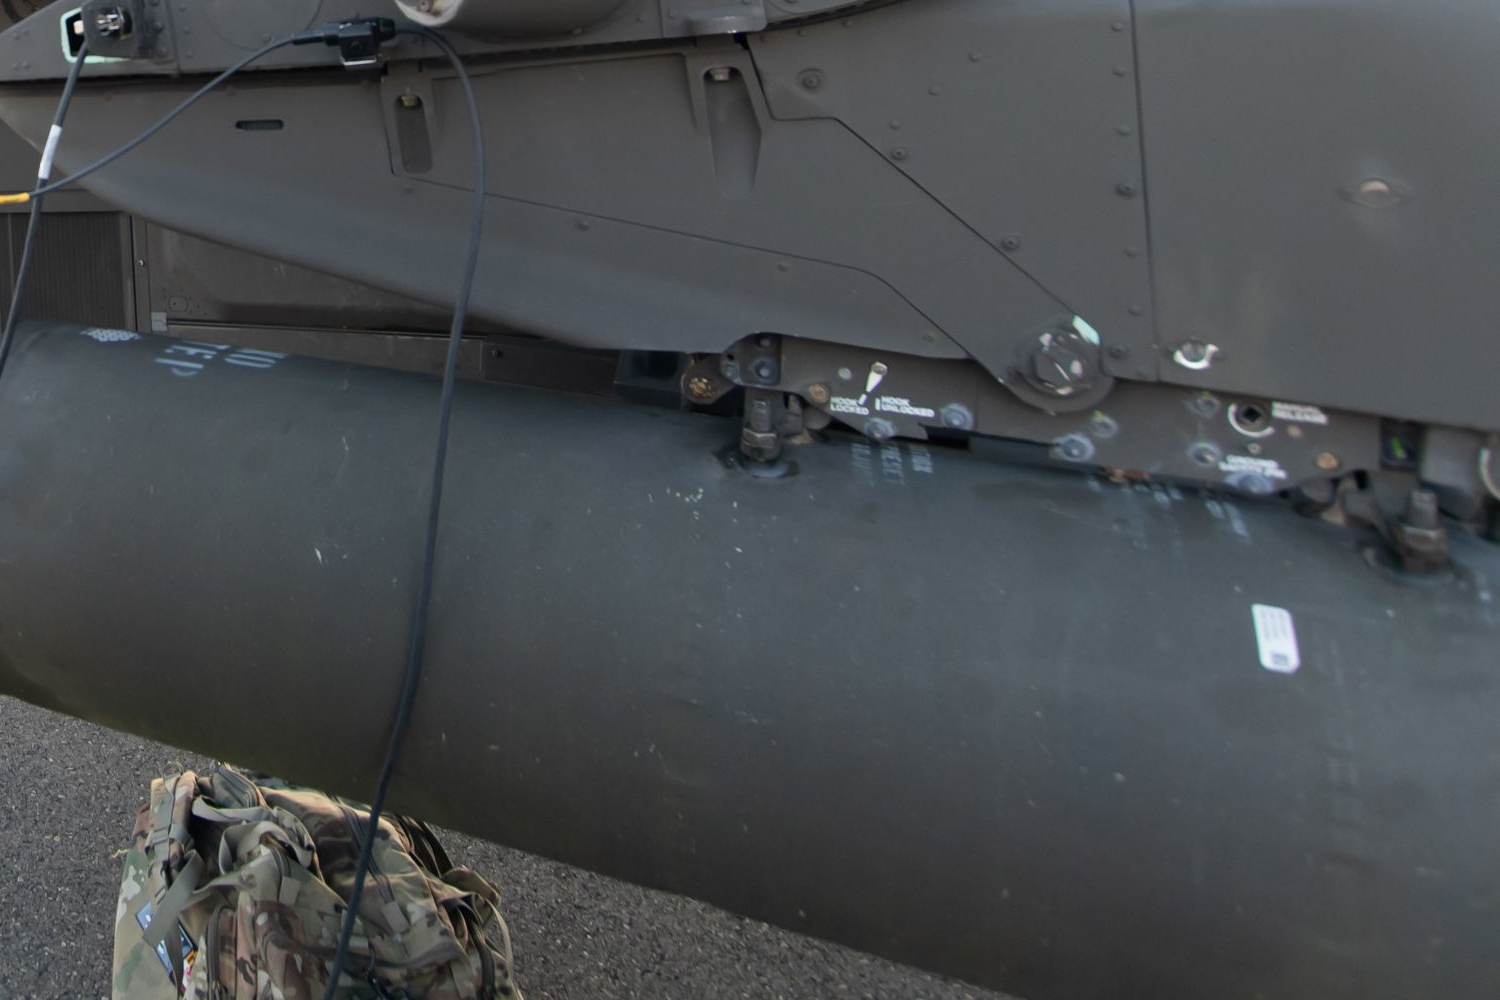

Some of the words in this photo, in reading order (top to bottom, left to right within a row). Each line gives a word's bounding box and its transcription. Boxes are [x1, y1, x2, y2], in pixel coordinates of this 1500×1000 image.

[155, 340, 230, 377] TEP
[830, 396, 858, 407] HOOK
[881, 395, 910, 407] HOOK
[830, 404, 870, 416] LOCKED
[881, 404, 936, 418] UNLOCKED
